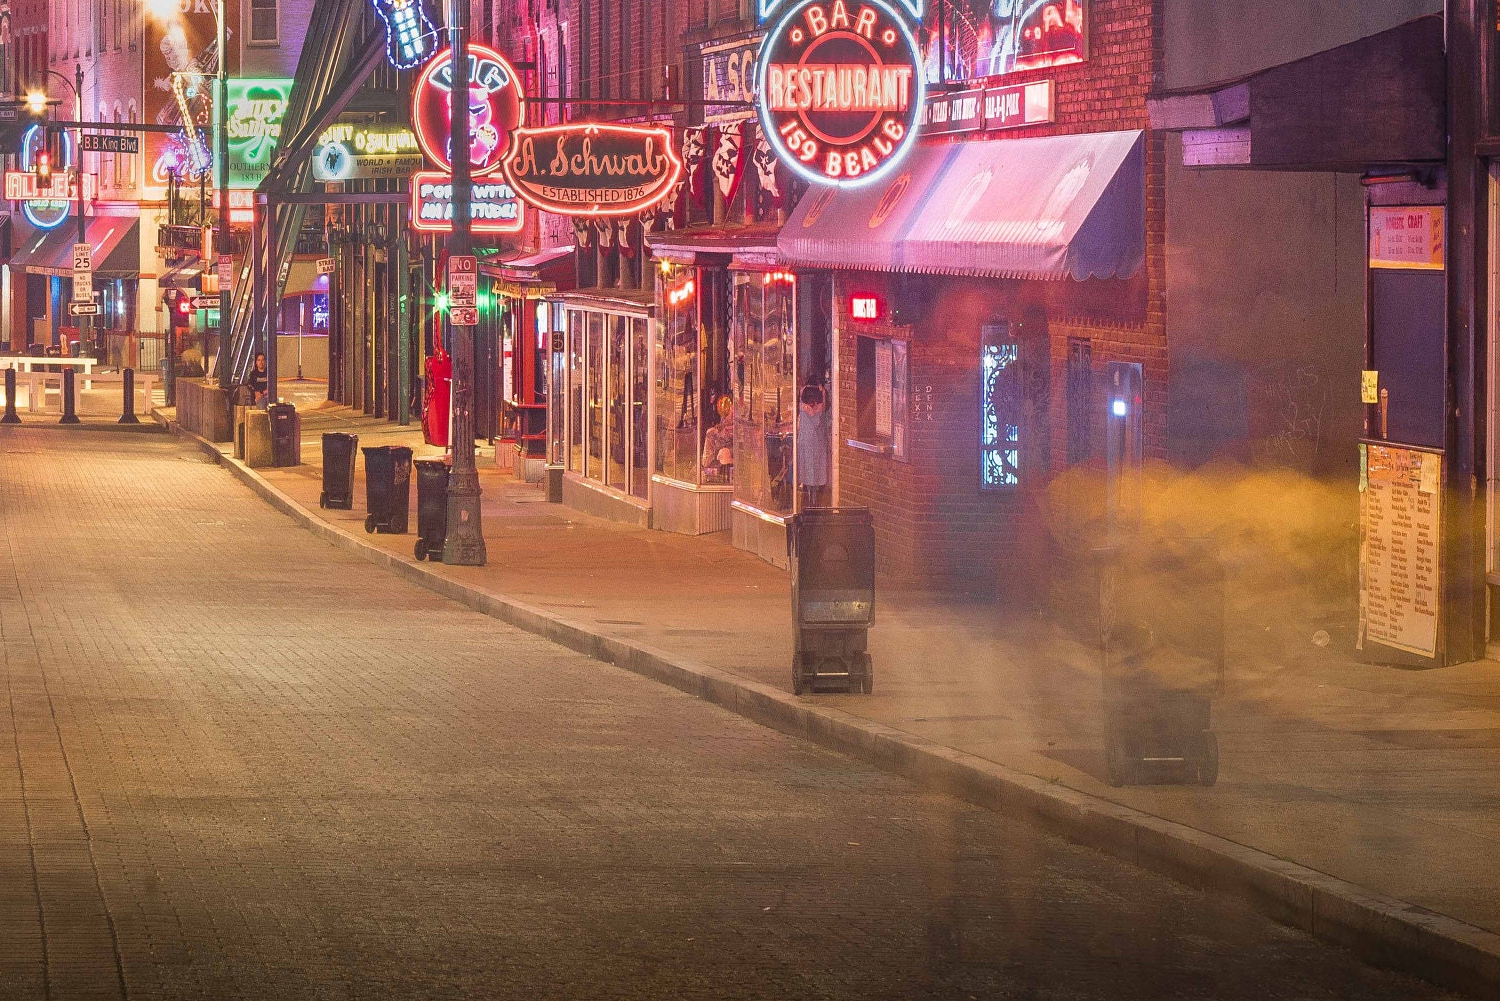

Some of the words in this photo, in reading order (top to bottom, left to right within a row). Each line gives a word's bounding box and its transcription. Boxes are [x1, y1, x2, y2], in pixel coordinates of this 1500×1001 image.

[807, 0, 877, 39] BAR
[769, 67, 912, 110] RESTAURANT
[84, 137, 102, 149] B.B.
[102, 138, 118, 151] King
[120, 138, 138, 152] Blvd.
[780, 120, 817, 162] 159
[825, 119, 905, 177] BEALE
[394, 158, 421, 166] FAMOU
[513, 136, 547, 177] A.
[550, 135, 665, 177] Schwab
[229, 163, 273, 171] OUTHERN
[371, 167, 393, 175] IRISH
[542, 187, 620, 202] ESTABLISHED
[622, 187, 646, 201] 1876
[75, 257, 90, 269] 25
[454, 259, 471, 271] NO
